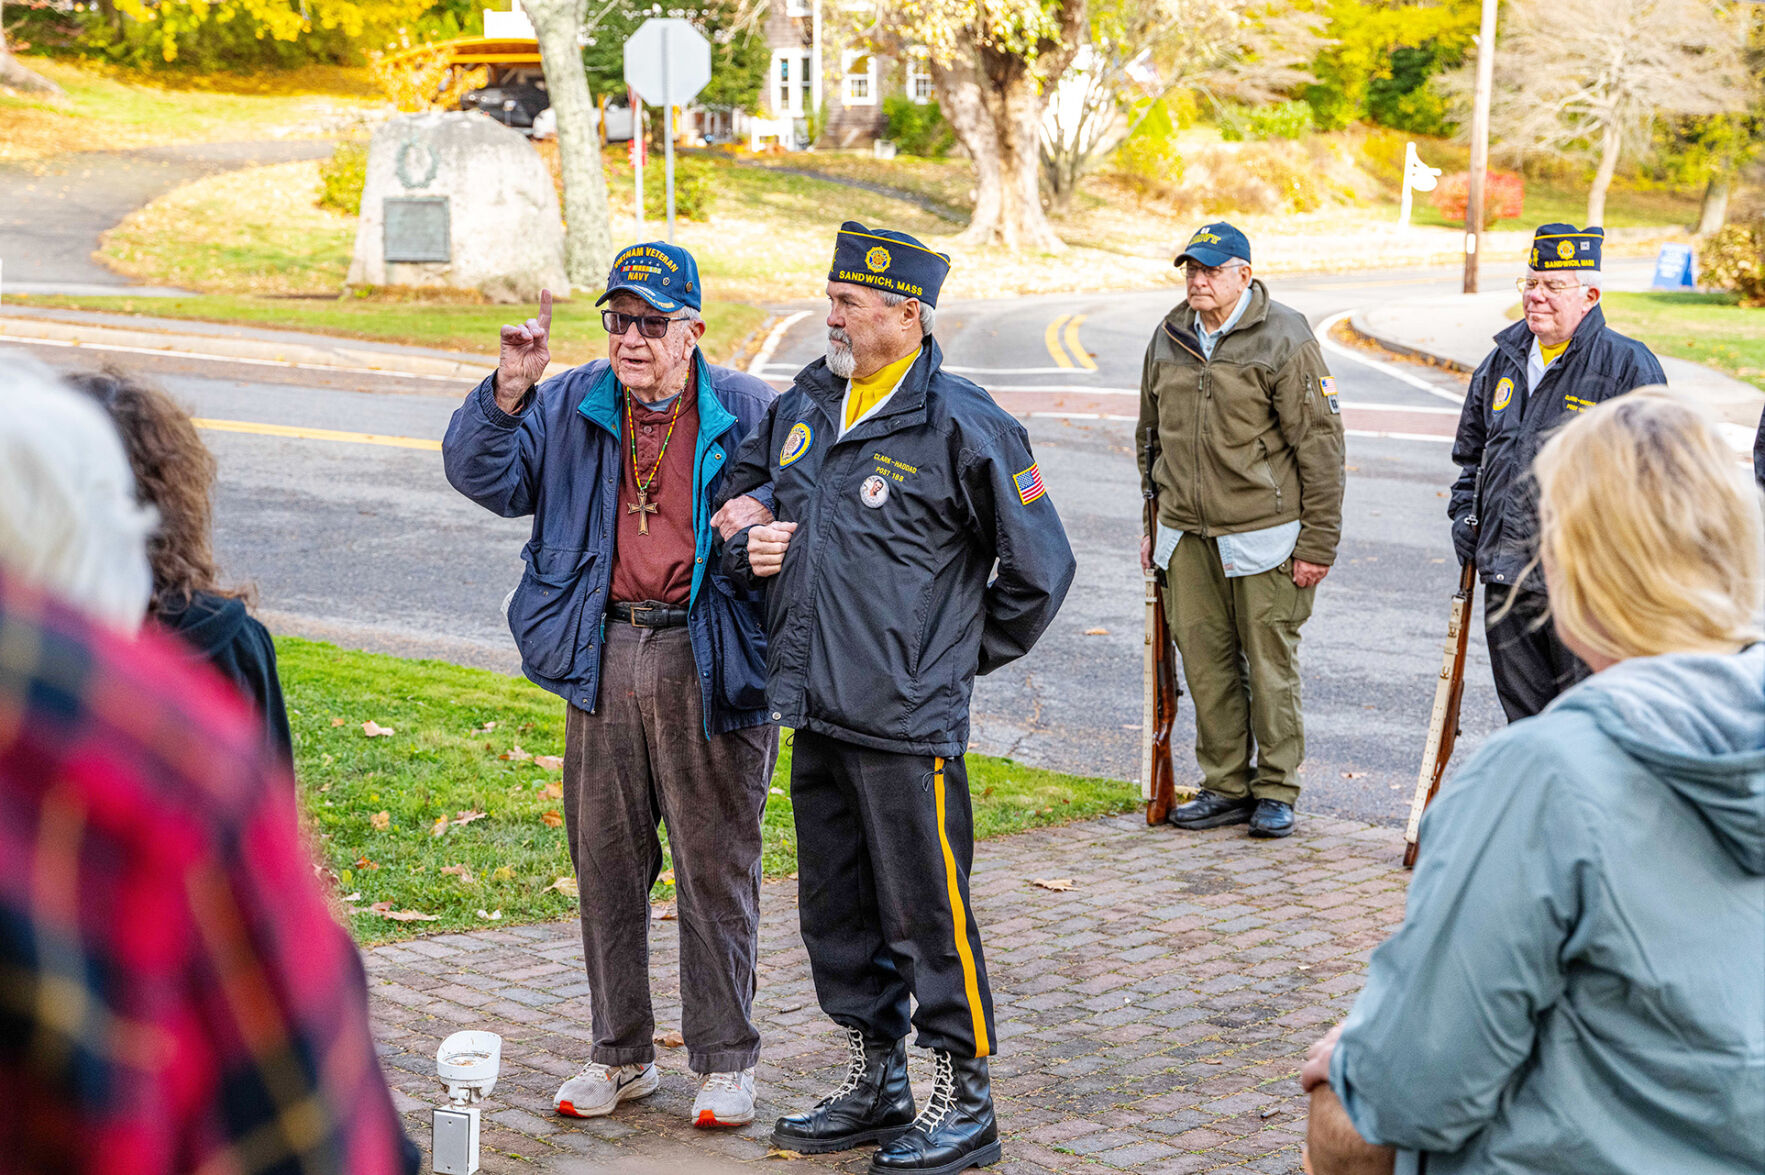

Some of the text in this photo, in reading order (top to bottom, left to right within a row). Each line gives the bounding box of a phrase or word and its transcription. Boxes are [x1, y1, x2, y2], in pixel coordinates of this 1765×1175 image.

[645, 246, 679, 273] VETERAN
[627, 271, 649, 282] NAVY
[838, 270, 923, 296] SANDWICH, MASS
[875, 466, 891, 477] POST
